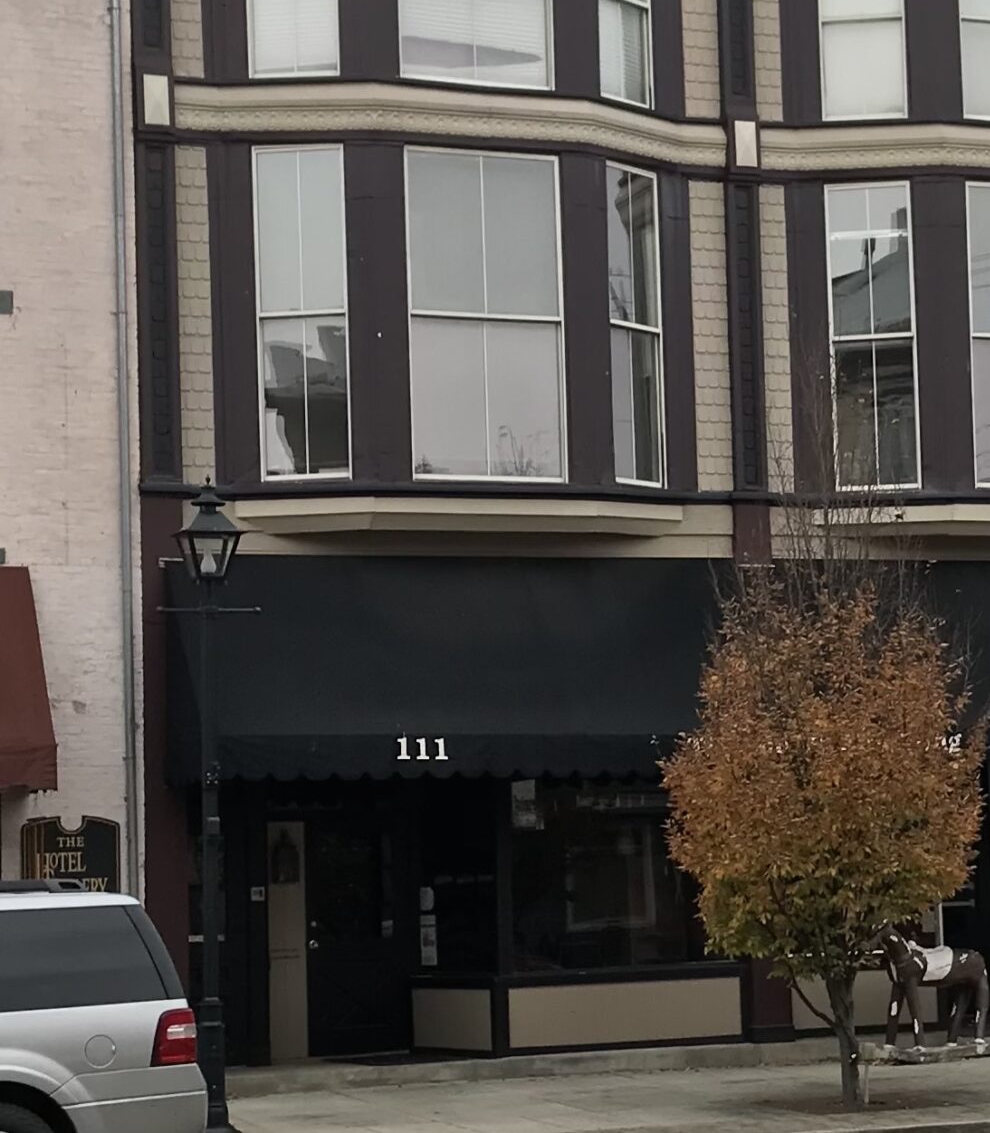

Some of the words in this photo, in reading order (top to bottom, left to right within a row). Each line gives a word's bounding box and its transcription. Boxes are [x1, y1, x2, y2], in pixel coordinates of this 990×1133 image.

[397, 737, 449, 760] 111
[56, 836, 85, 848] THE
[37, 851, 87, 878] HOTEL
